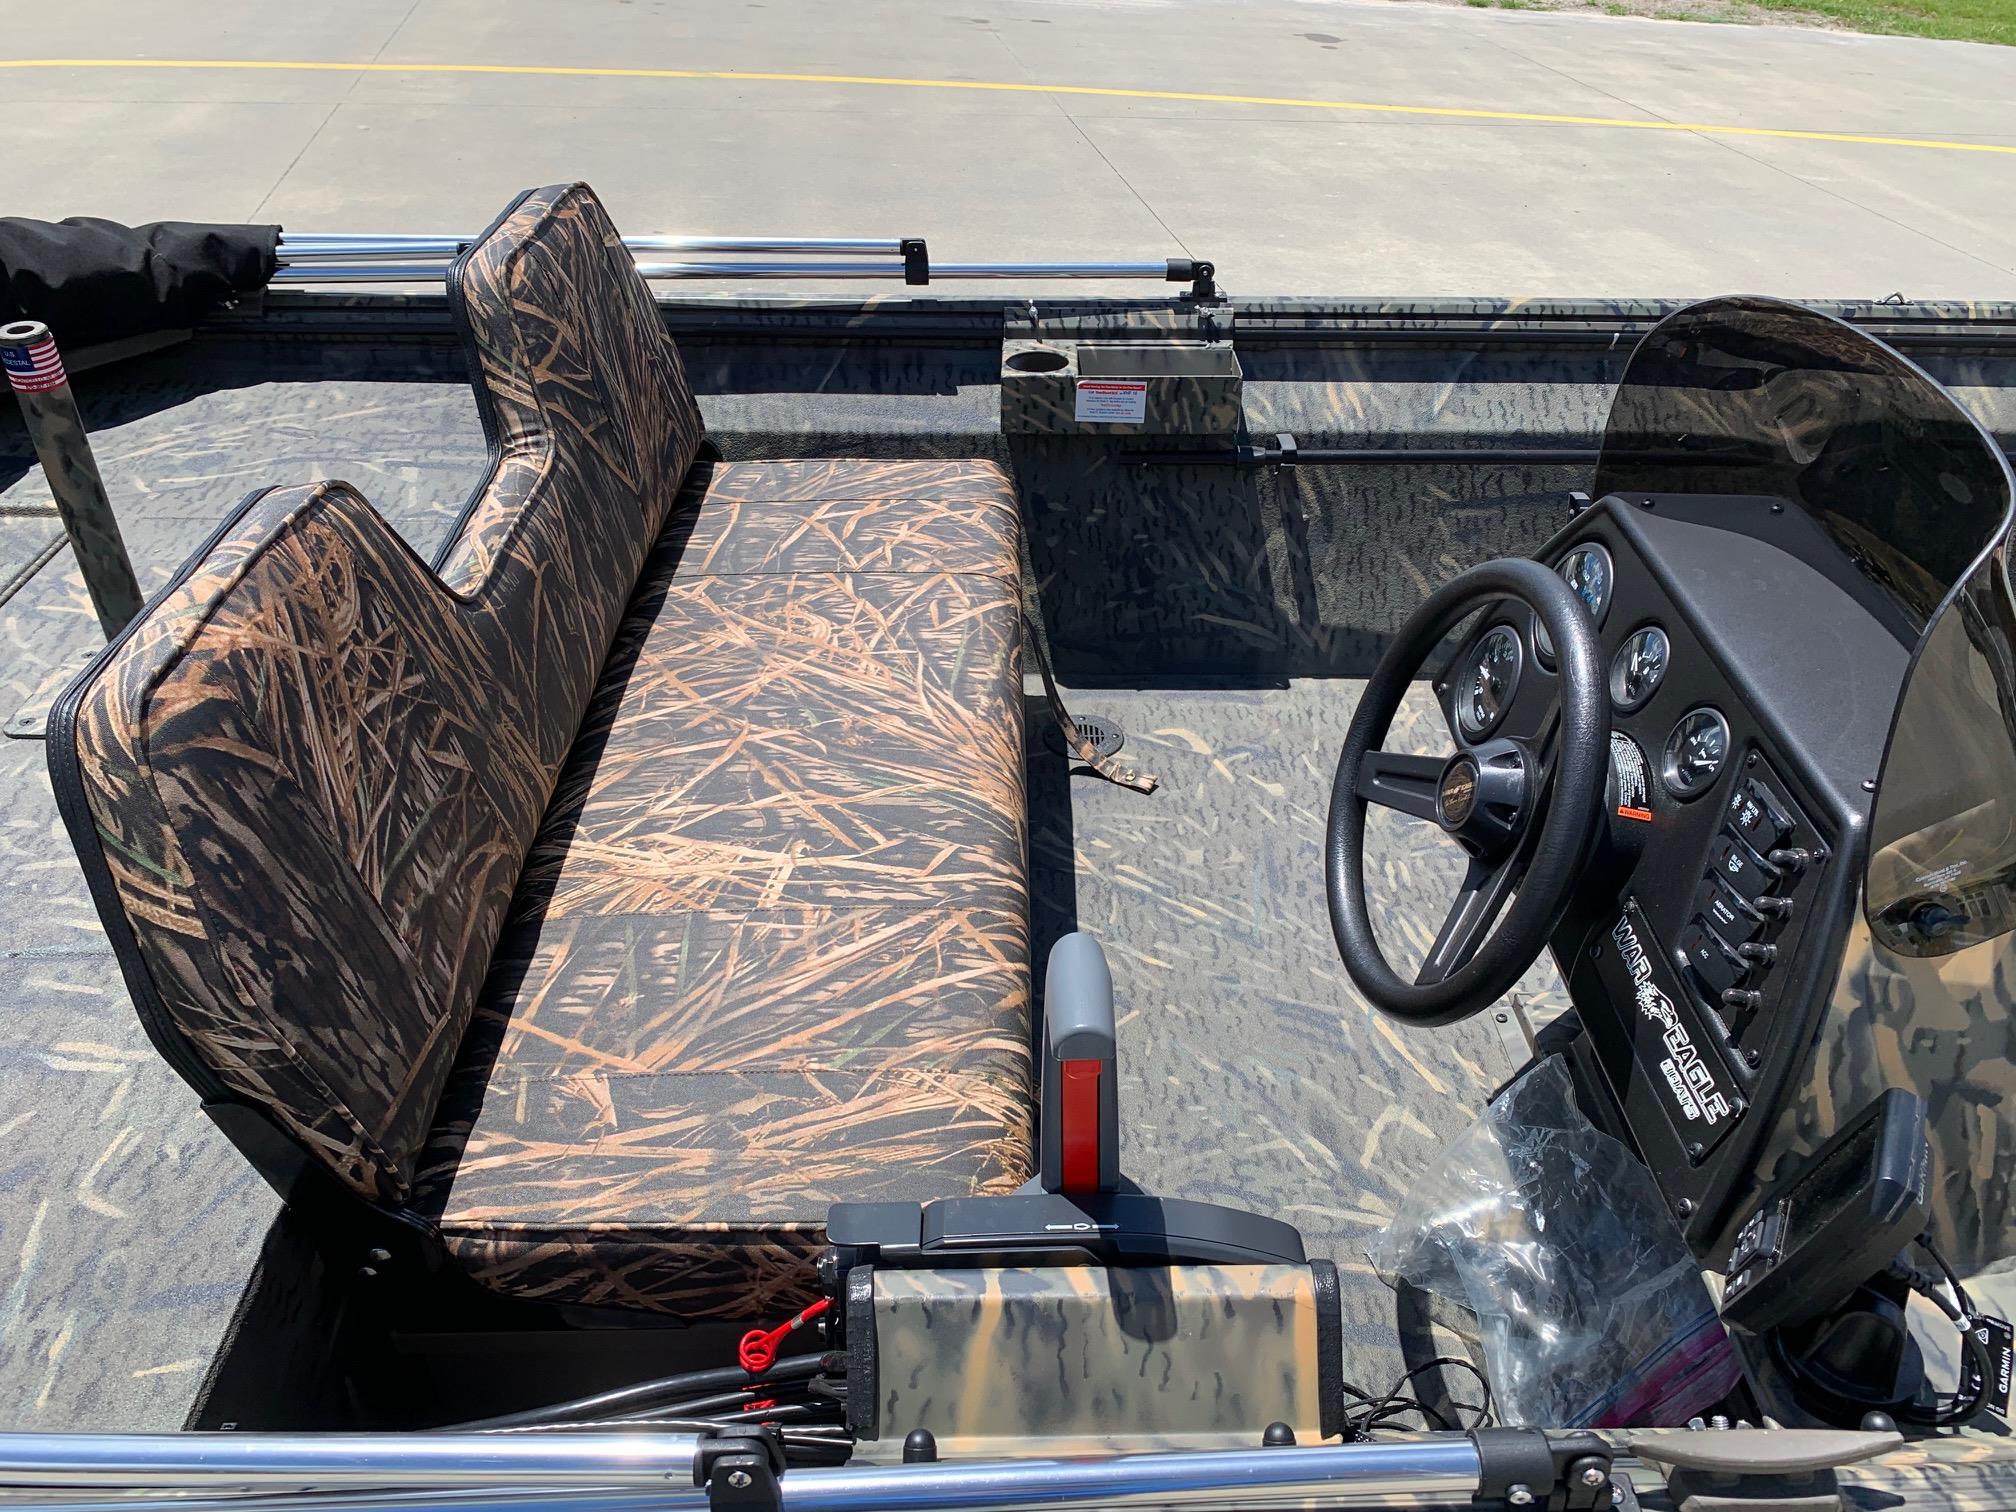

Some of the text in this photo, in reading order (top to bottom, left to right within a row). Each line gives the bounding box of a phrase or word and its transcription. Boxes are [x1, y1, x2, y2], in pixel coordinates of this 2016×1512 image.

[1624, 810, 1650, 820] WARNING
[1731, 854, 1744, 869] BILGE
[1714, 900, 1735, 921] AERATOR
[1611, 915, 1730, 1125] WAR EAGLE
[1660, 1058, 1701, 1121] BOATS
[1998, 1347, 2012, 1394] GARMIN
